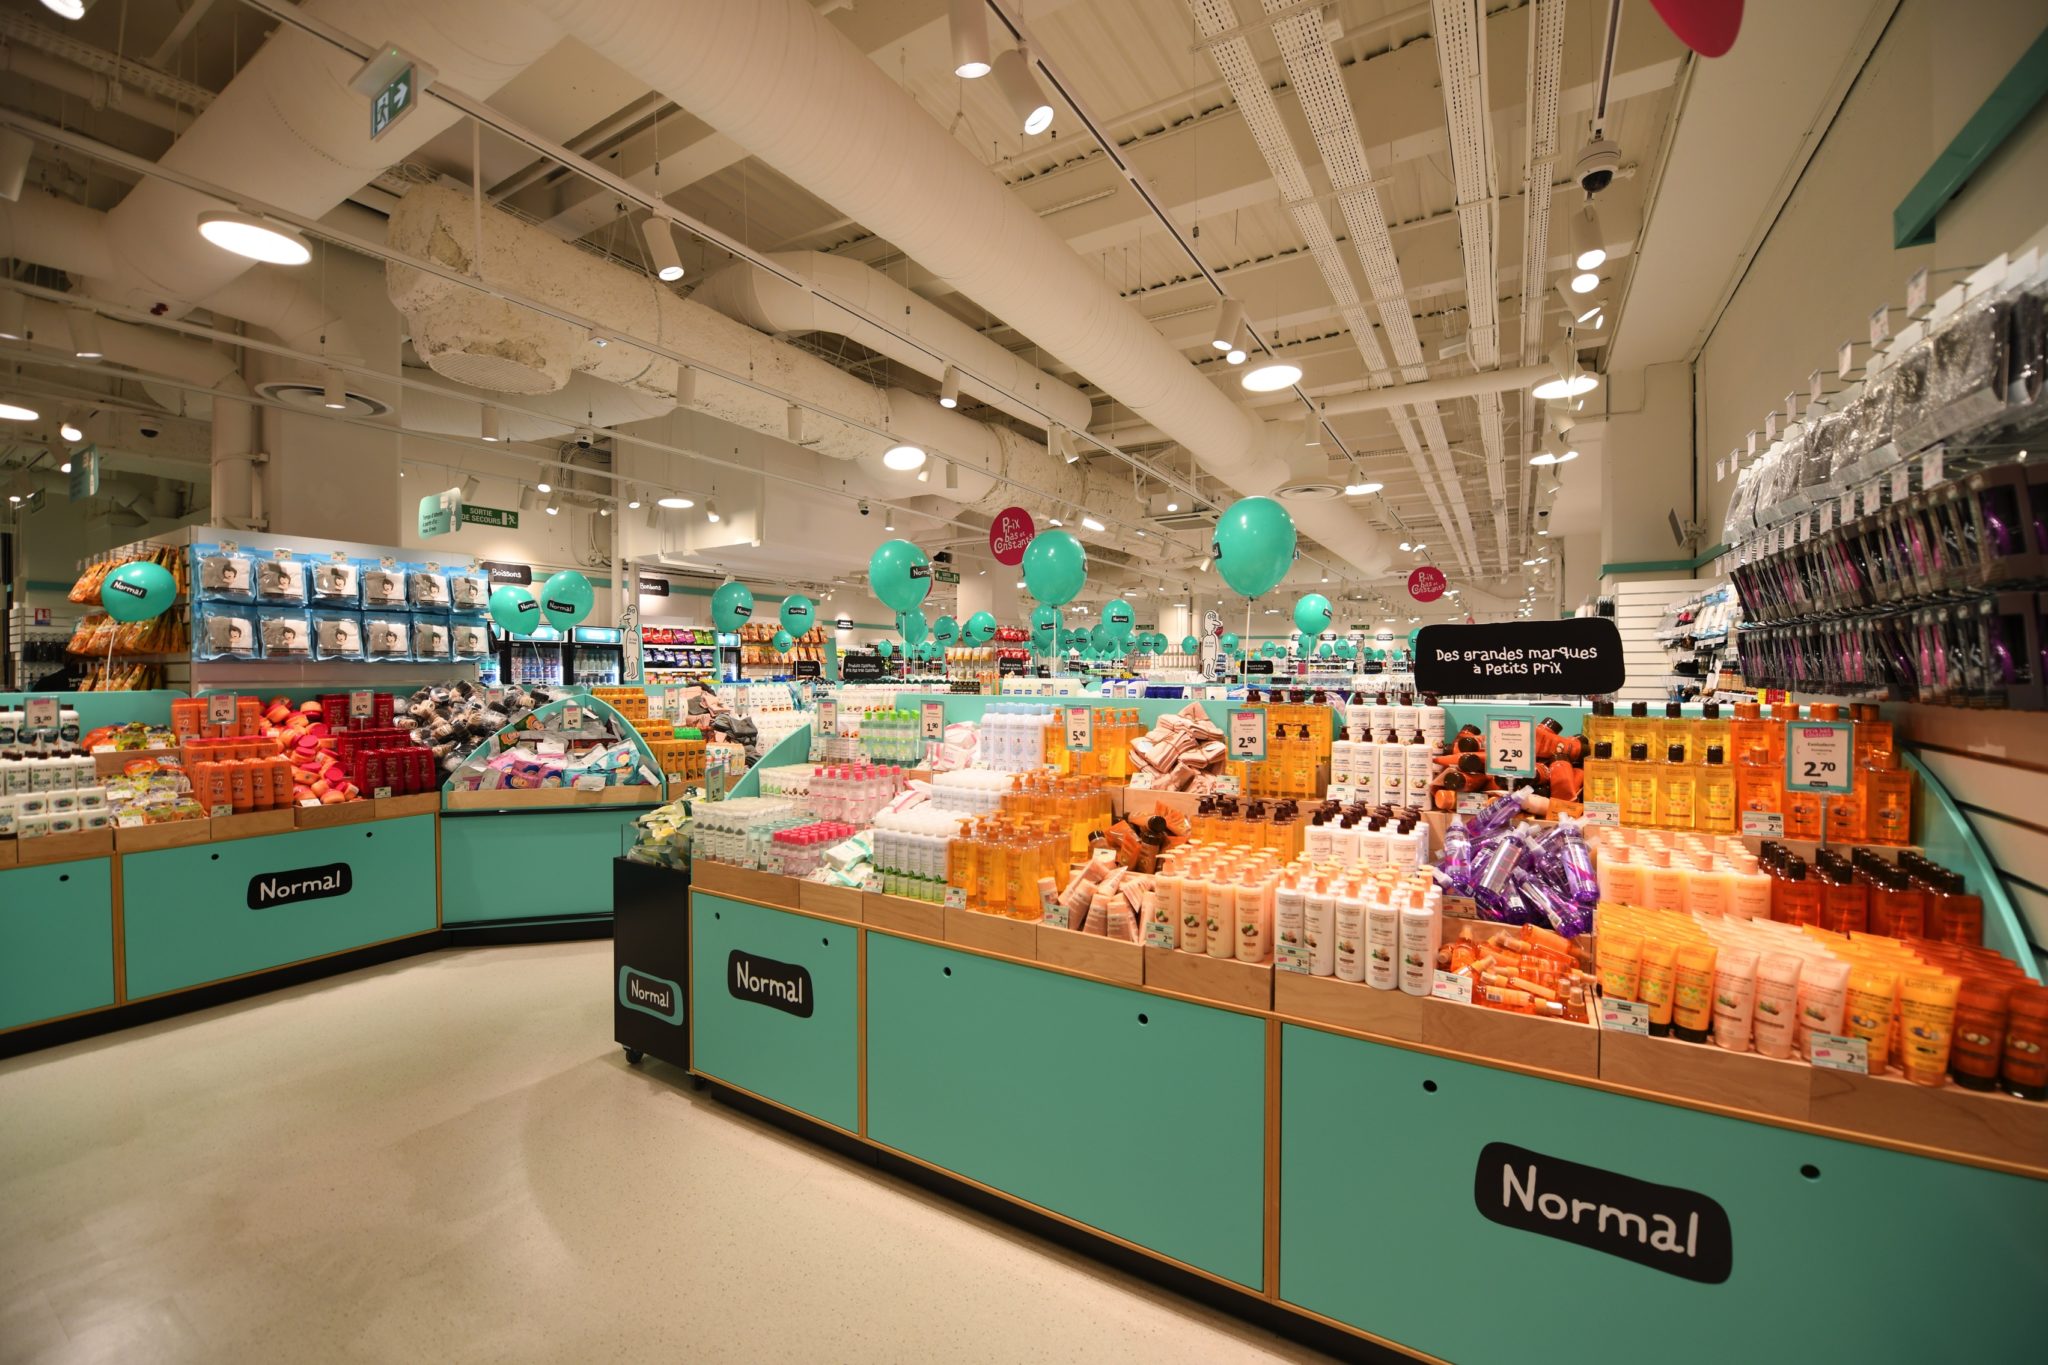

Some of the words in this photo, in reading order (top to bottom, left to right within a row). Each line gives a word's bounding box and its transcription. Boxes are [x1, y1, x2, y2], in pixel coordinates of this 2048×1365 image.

[469, 508, 493, 517] SORTIE
[471, 515, 501, 525] SECOURS
[1002, 517, 1021, 533] Prix
[1005, 529, 1019, 542] bas
[491, 568, 522, 578] Boissons
[113, 581, 144, 596] Normal
[640, 582, 662, 591] Bonbons
[549, 602, 573, 613] Normal
[1436, 649, 1460, 662] Des
[1464, 646, 1524, 662] grandes
[1528, 646, 1598, 660] marques
[1473, 664, 1482, 675] à
[1238, 736, 1257, 748] 2.90
[1499, 749, 1523, 762] 2.30
[1804, 761, 1836, 777] 2.70
[260, 870, 341, 902] Normal
[736, 961, 803, 1004] Normal
[631, 979, 670, 1009] Normal
[1502, 1163, 1699, 1258] Normal
